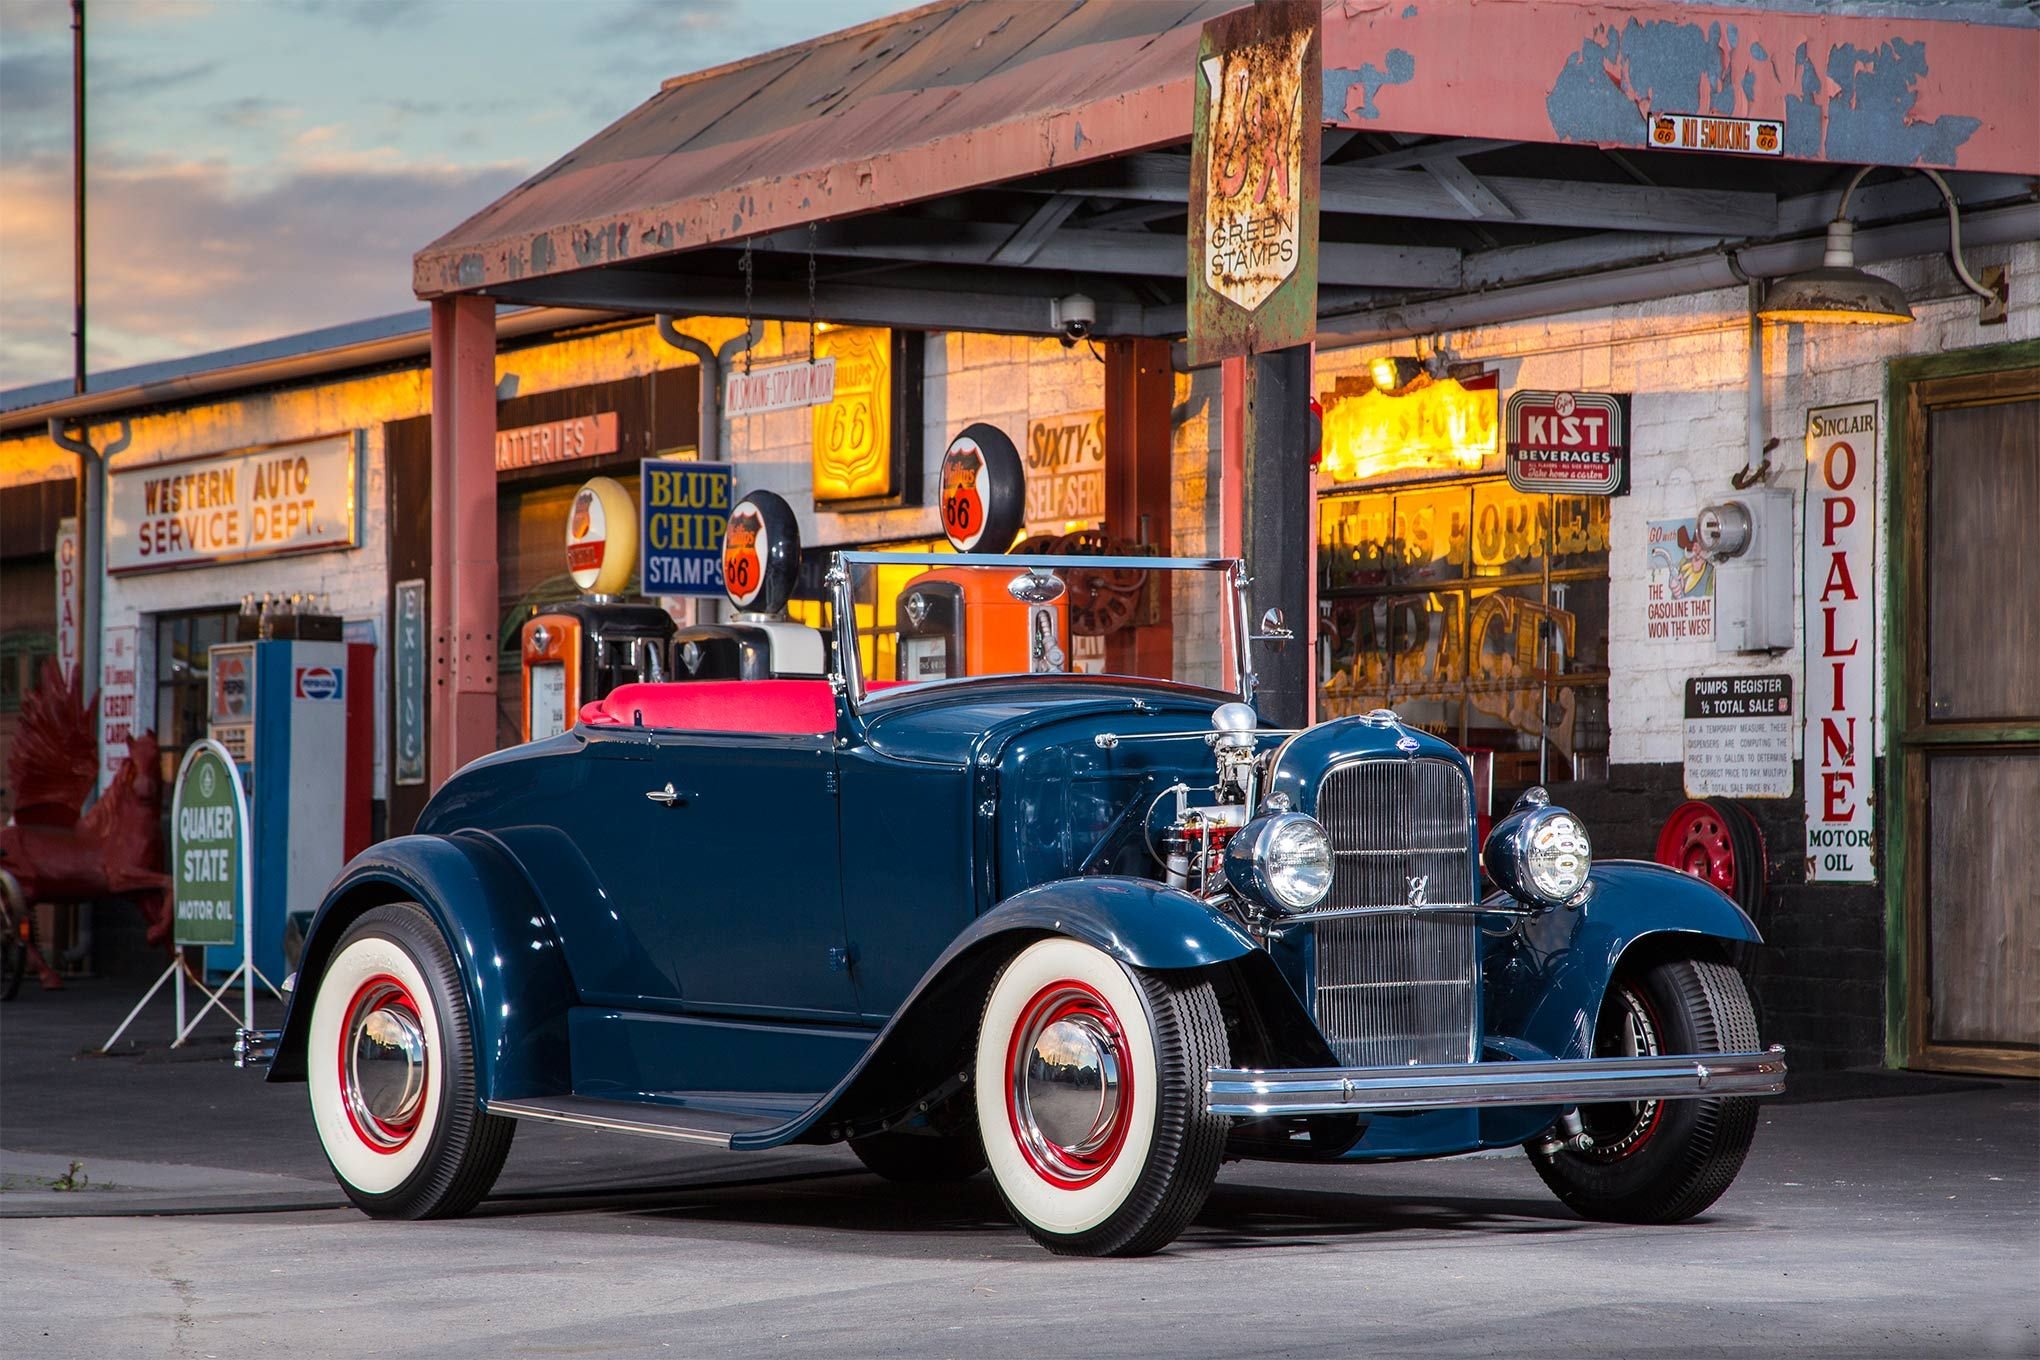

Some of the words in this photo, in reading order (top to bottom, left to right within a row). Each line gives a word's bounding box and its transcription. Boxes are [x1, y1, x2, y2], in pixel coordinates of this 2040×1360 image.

[1658, 131, 1671, 141] 66
[1682, 118, 1697, 147] NO
[1701, 120, 1750, 150] SMOKING
[1761, 137, 1773, 148] 66
[1212, 212, 1293, 248] GREEN
[1212, 239, 1293, 276] STAMPS
[830, 401, 867, 453] 66
[1528, 416, 1603, 446] KIST
[496, 421, 585, 468] ATTERIES
[1519, 450, 1611, 463] BEVERAGES
[1528, 468, 1547, 478] Take
[1549, 469, 1568, 478] home
[1577, 470, 1602, 479] carton
[144, 467, 235, 516] WESTERN
[254, 456, 309, 501] AUTO
[650, 471, 728, 509] BLUE
[1027, 477, 1063, 521] SELF
[947, 496, 970, 529] 66
[139, 510, 239, 556] SERVICE
[254, 500, 324, 542] DEPT.
[650, 513, 728, 550] CHIP
[1650, 527, 1663, 543] GO
[1663, 530, 1677, 541] with
[650, 556, 724, 585] STAMPS
[728, 558, 750, 587] 66
[1649, 584, 1663, 601] THE
[1648, 601, 1689, 620] GASOLINE
[1691, 600, 1711, 616] THAT
[1648, 622, 1669, 638] WON
[1671, 620, 1686, 637] THE
[1688, 619, 1711, 636] WEST
[1820, 441, 1857, 822] OPALINE
[1695, 681, 1728, 695] PUMPS
[1734, 679, 1782, 693] REGISTER
[1701, 701, 1710, 714] ½
[1714, 700, 1745, 714] TOTAL
[1749, 699, 1774, 712] SALE
[1706, 724, 1737, 733] TEMPORARY
[1771, 724, 1787, 732] THESE
[1689, 741, 1719, 749] DISPENSERS
[1725, 740, 1734, 748] ARE
[1740, 740, 1771, 748] COMPUTING
[1689, 755, 1703, 763] PRICE
[1724, 754, 1744, 762] GALLON
[1748, 754, 1754, 762] TO
[1757, 754, 1787, 762] DETERMINE
[1689, 769, 1698, 778] THE
[1701, 769, 1723, 777] CORRECT
[1725, 769, 1739, 777] PRICE
[1742, 769, 1748, 777] TO
[1750, 768, 1760, 777] PAY
[1763, 768, 1787, 777] MULTIPLY
[1712, 784, 1728, 792] TOTAL
[1730, 784, 1743, 792] SALE
[1746, 784, 1761, 792] PRICE
[1763, 784, 1771, 792] BY
[181, 806, 233, 843] QUAKER
[1809, 830, 1870, 847] MOTOR
[184, 848, 229, 882] STATE
[1825, 854, 1853, 871] OIL
[178, 900, 214, 920] MOTOR
[216, 900, 232, 920] OIL
